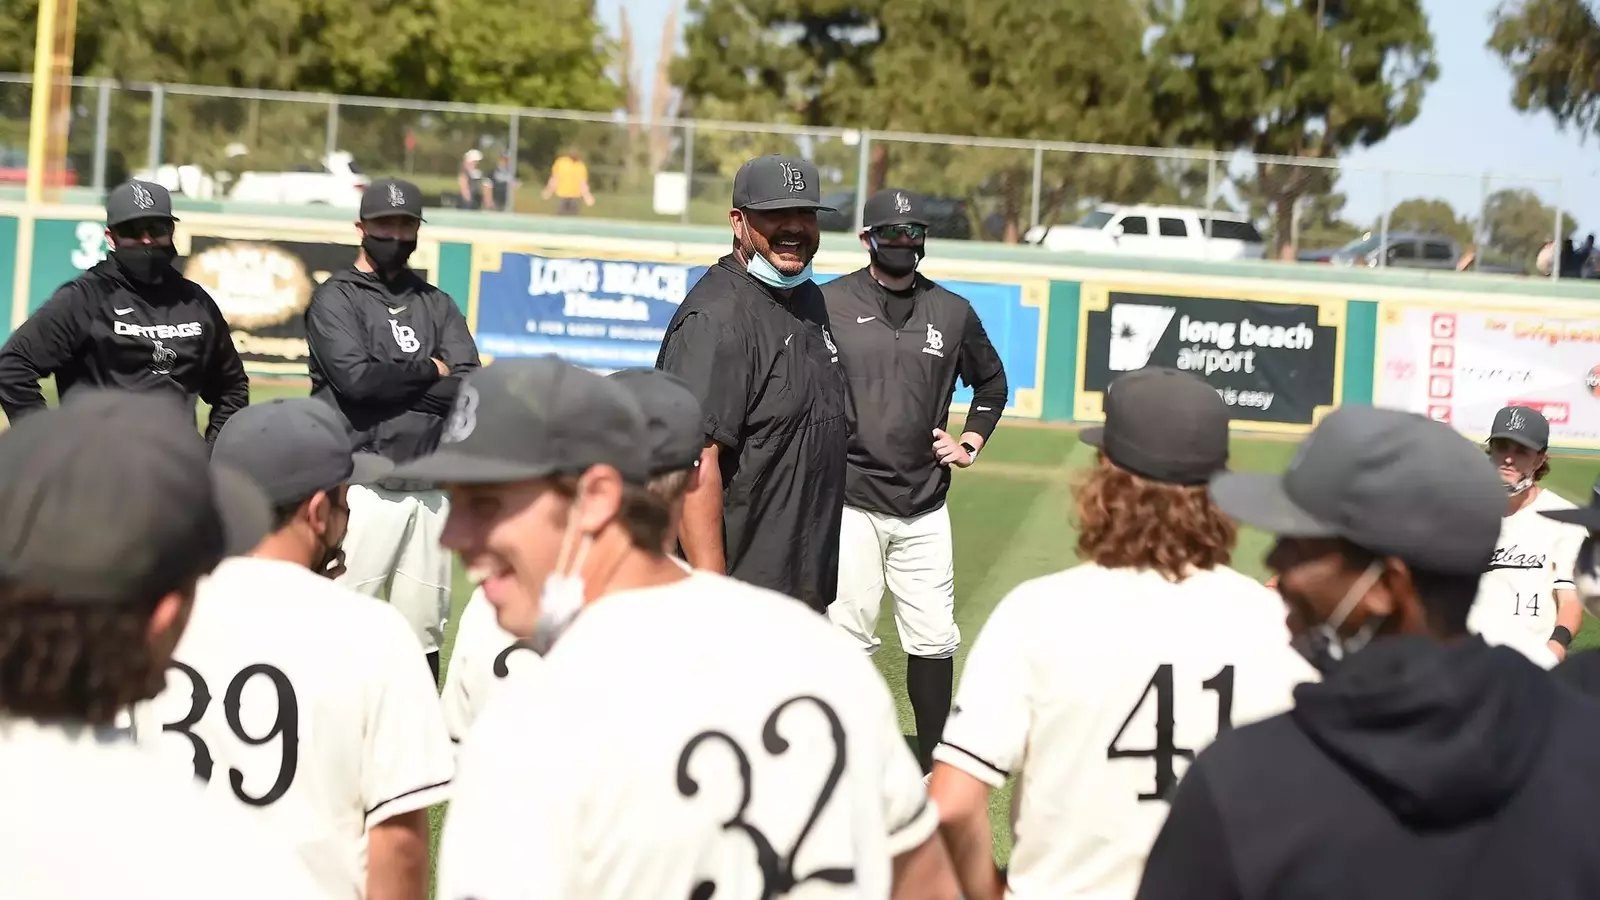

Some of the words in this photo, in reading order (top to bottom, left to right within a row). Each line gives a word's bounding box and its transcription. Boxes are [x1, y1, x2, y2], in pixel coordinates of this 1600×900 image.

[1179, 314, 1236, 349] long
[1240, 318, 1314, 350] beach
[1176, 344, 1256, 376] airport
[1238, 390, 1275, 411] easy
[1512, 592, 1541, 617] 14
[162, 659, 299, 807] 39
[1106, 663, 1236, 802] 41
[675, 695, 857, 900] 32
